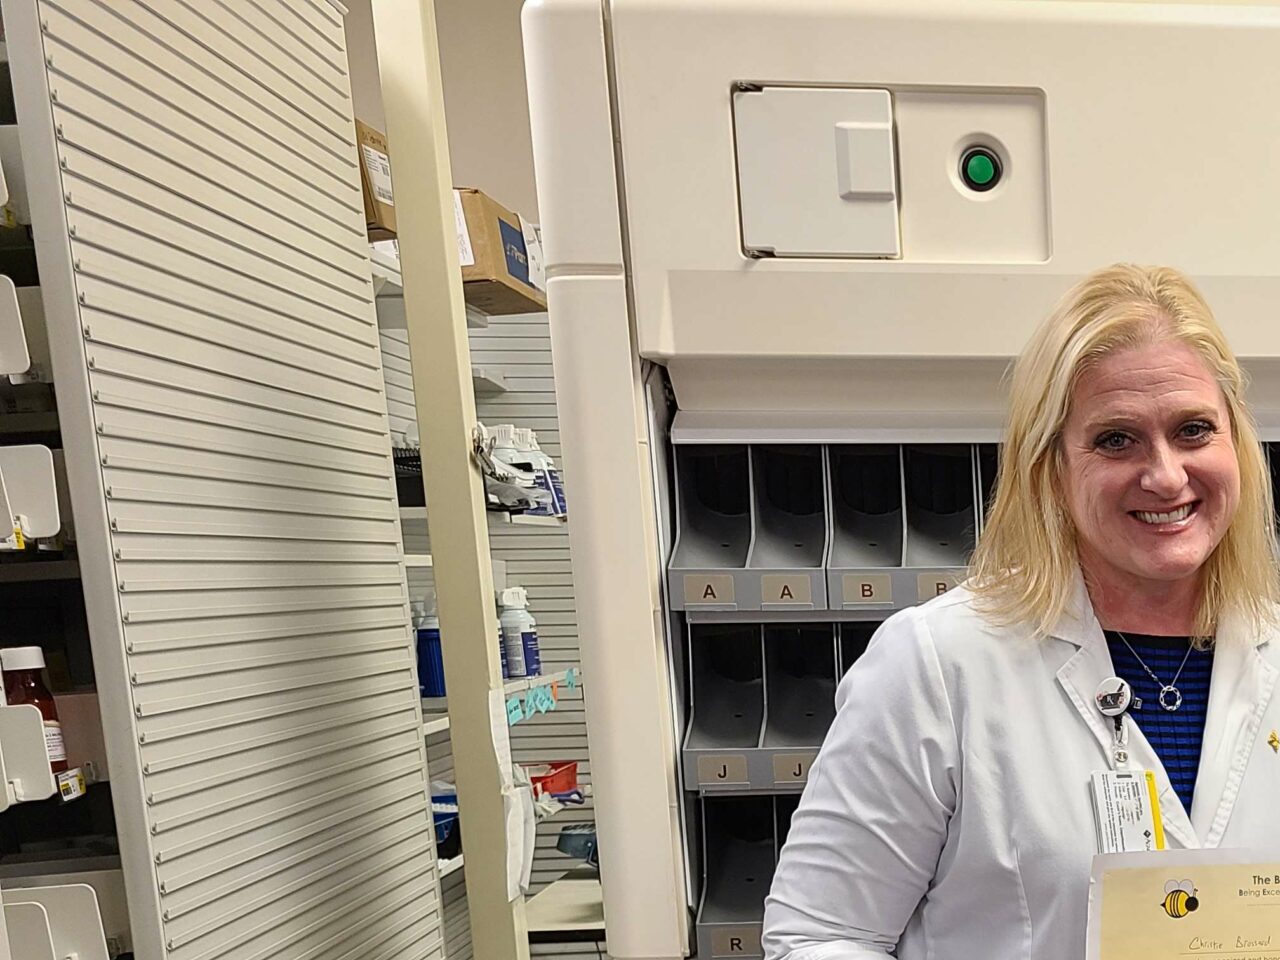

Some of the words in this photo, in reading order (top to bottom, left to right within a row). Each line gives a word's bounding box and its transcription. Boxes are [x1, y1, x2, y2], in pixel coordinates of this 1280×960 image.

[702, 584, 717, 599] A
[780, 584, 794, 600] A
[861, 584, 874, 598] B
[936, 582, 948, 596] B
[717, 764, 727, 778] J
[792, 763, 802, 777] J
[1252, 875, 1271, 884] The
[1238, 888, 1260, 898] Being
[730, 936, 743, 951] R
